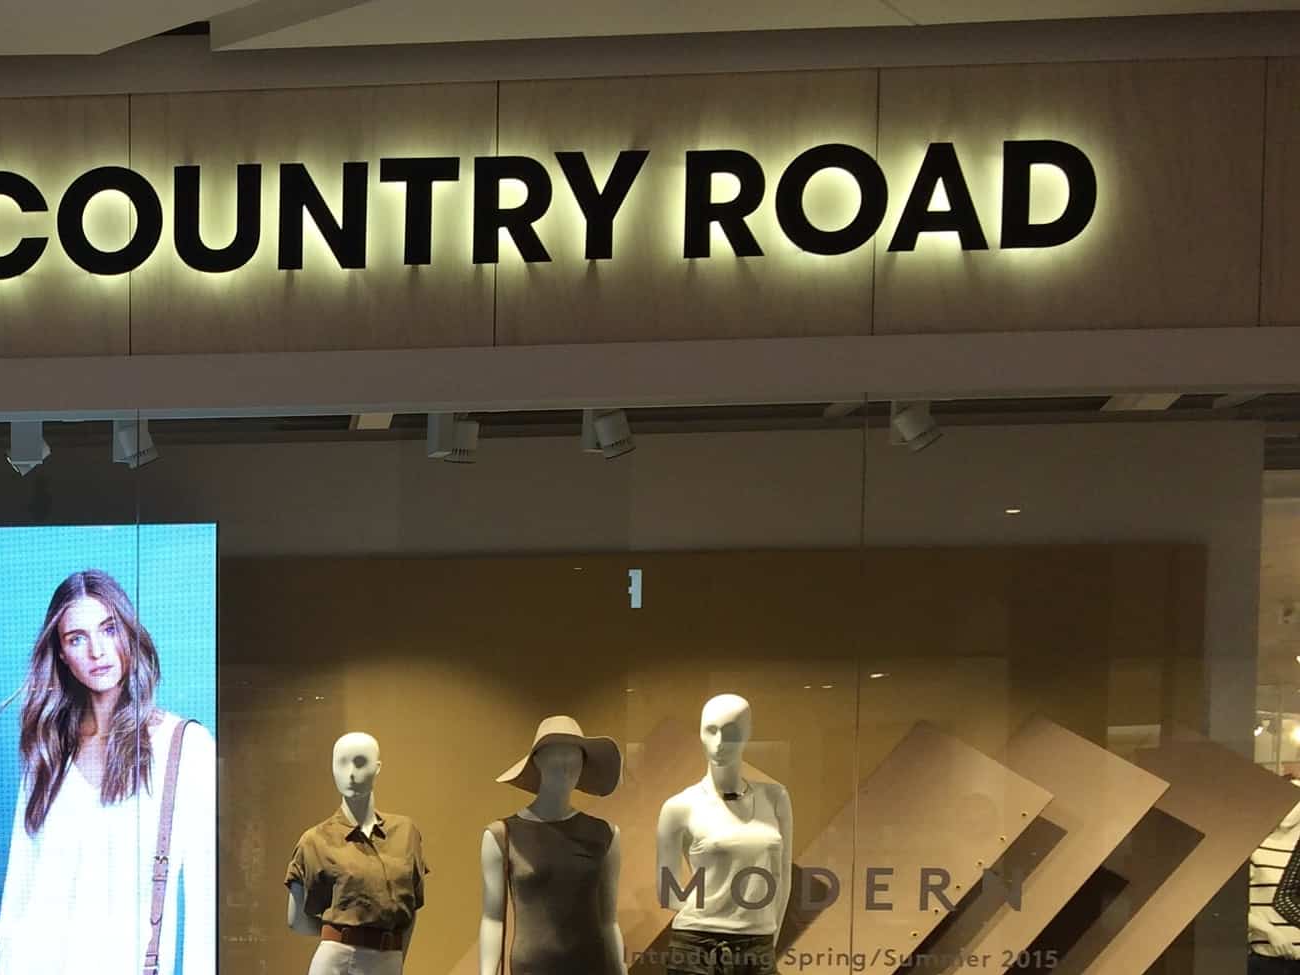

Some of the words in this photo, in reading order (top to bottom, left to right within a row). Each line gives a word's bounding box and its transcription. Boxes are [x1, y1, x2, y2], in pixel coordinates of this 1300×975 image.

[683, 139, 1098, 259] ROAD
[659, 866, 1023, 912] MODERN
[623, 946, 773, 971] Introducing
[784, 947, 992, 972] Spring/Summer
[1001, 949, 1059, 969] 2015
